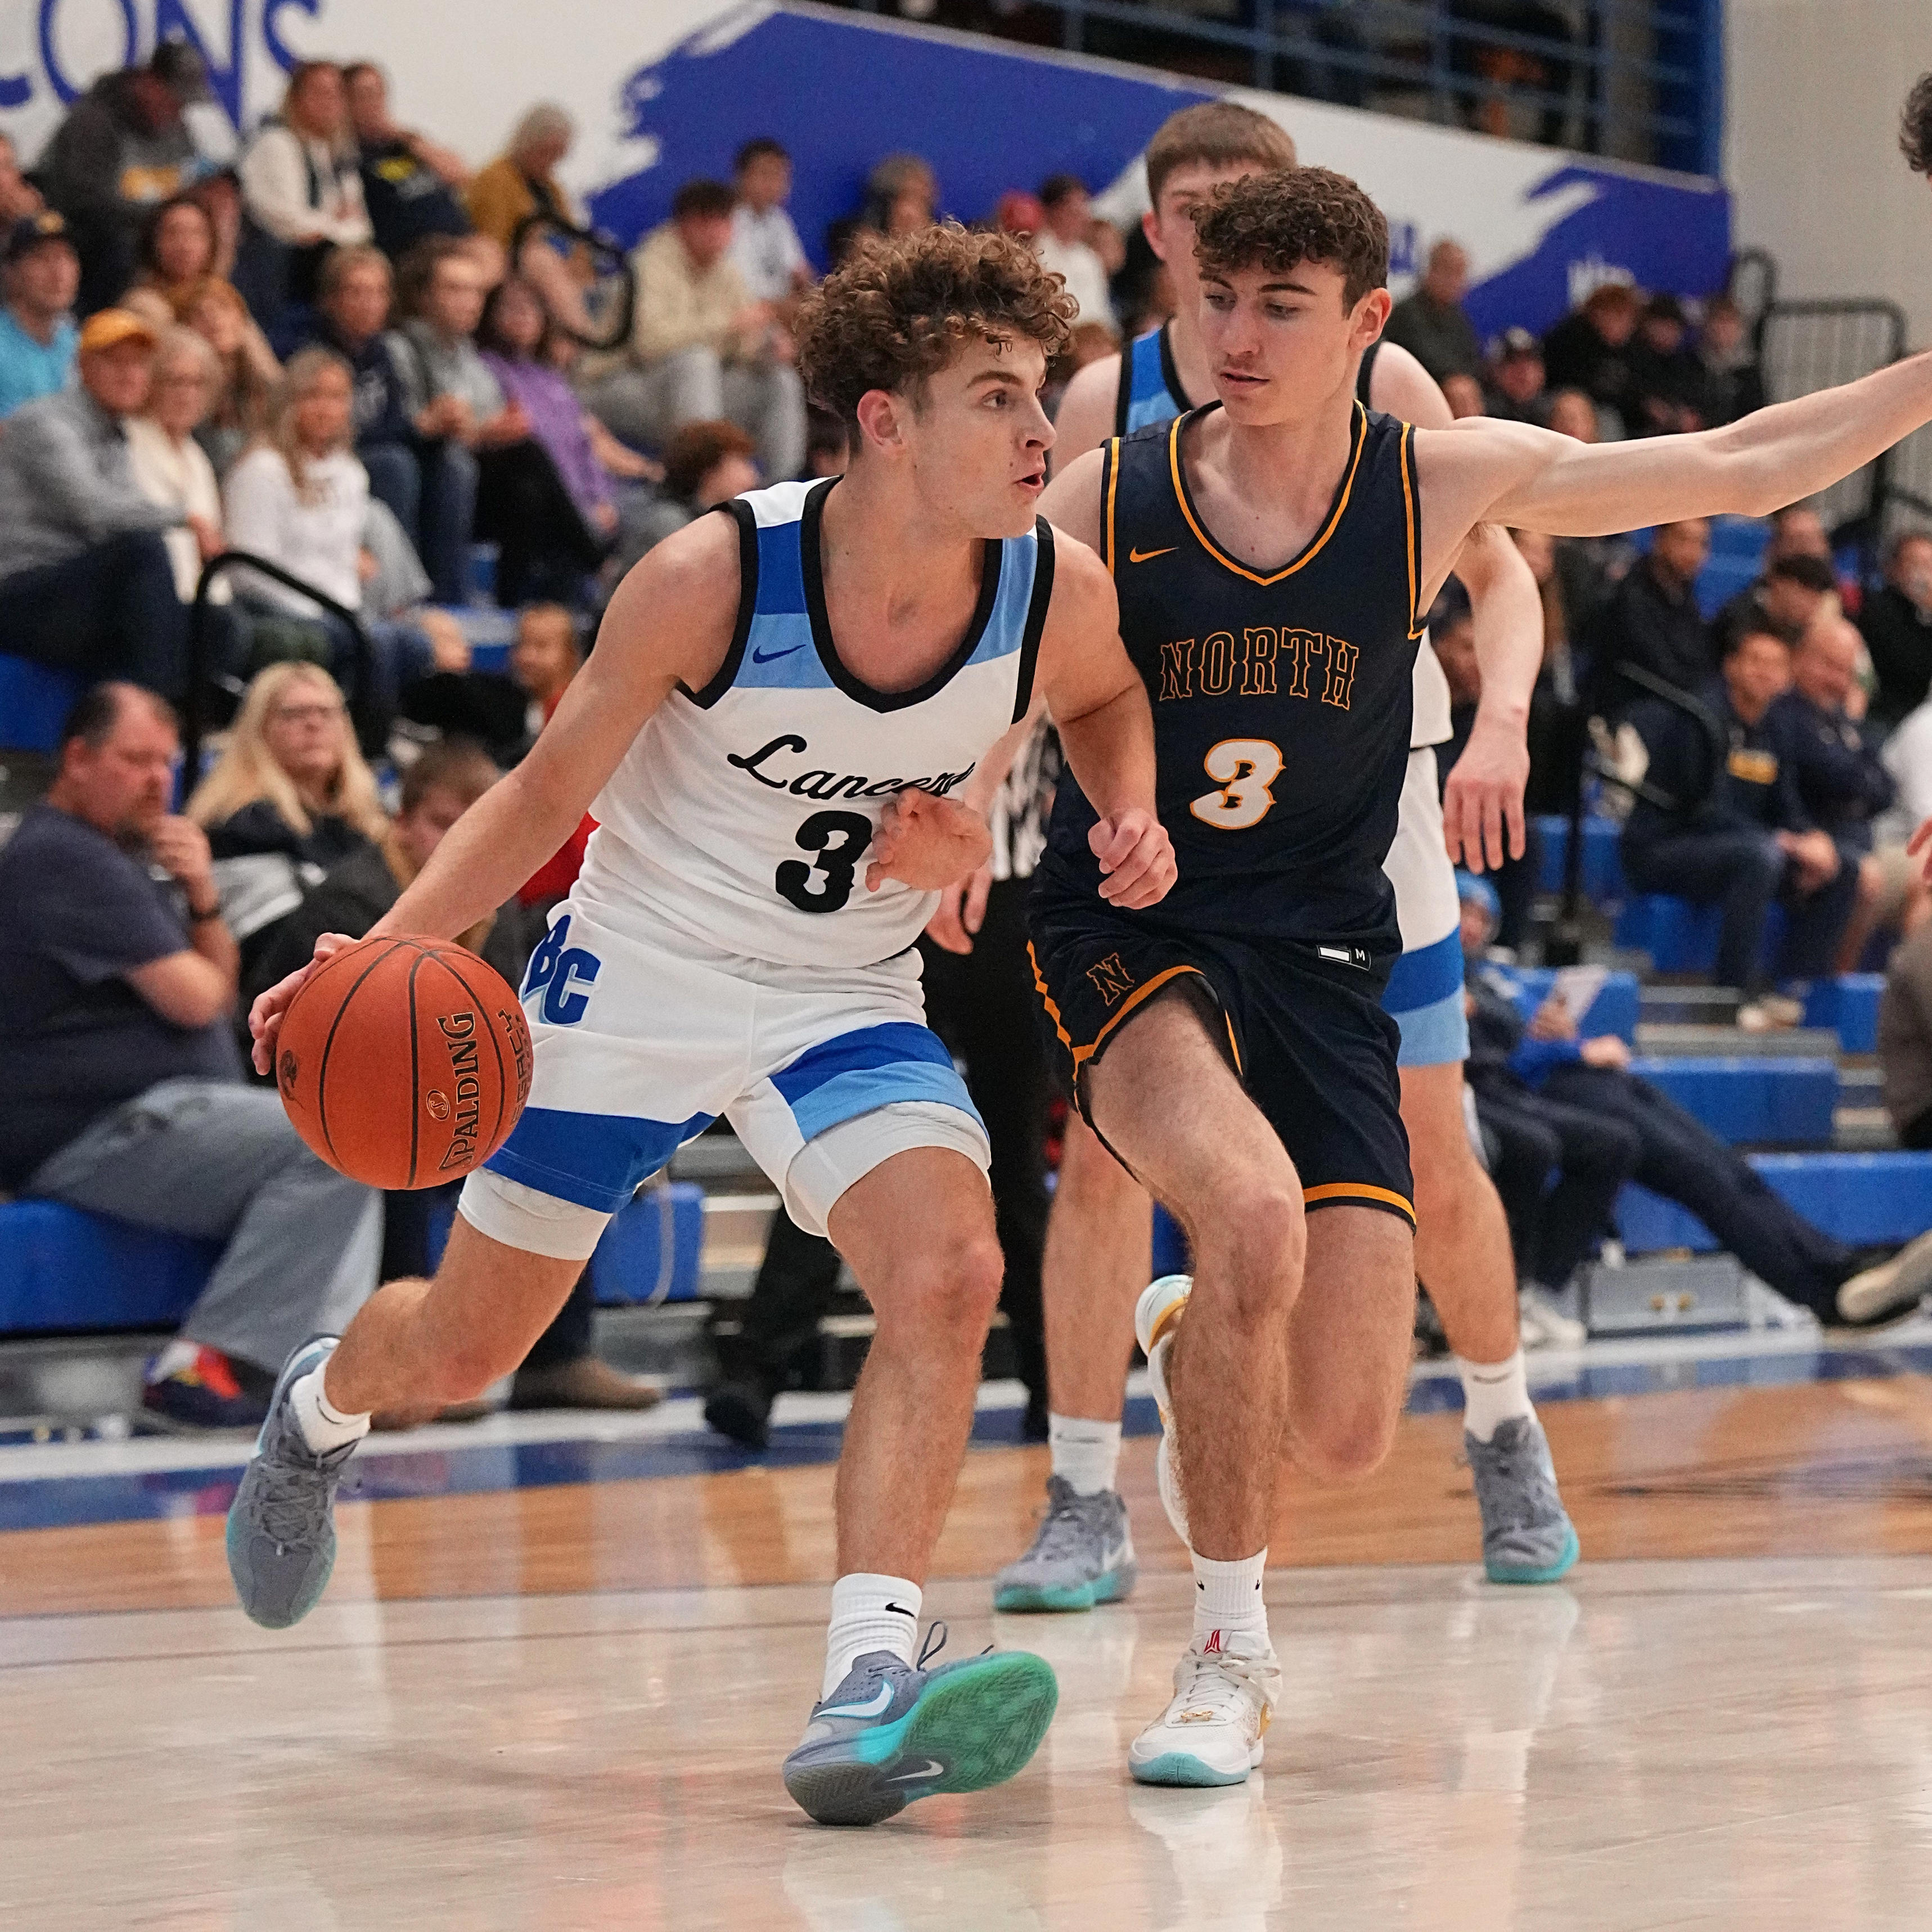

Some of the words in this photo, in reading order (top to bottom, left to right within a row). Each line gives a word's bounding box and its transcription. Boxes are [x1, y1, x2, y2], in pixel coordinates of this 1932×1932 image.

[1159, 627, 1359, 710] NORTH
[1189, 738, 1286, 830] 3
[776, 810, 873, 913] 3
[520, 914, 602, 1025] BC
[1086, 951, 1136, 1007] N
[1354, 948, 1366, 961] M
[436, 1011, 480, 1171] SPALDING
